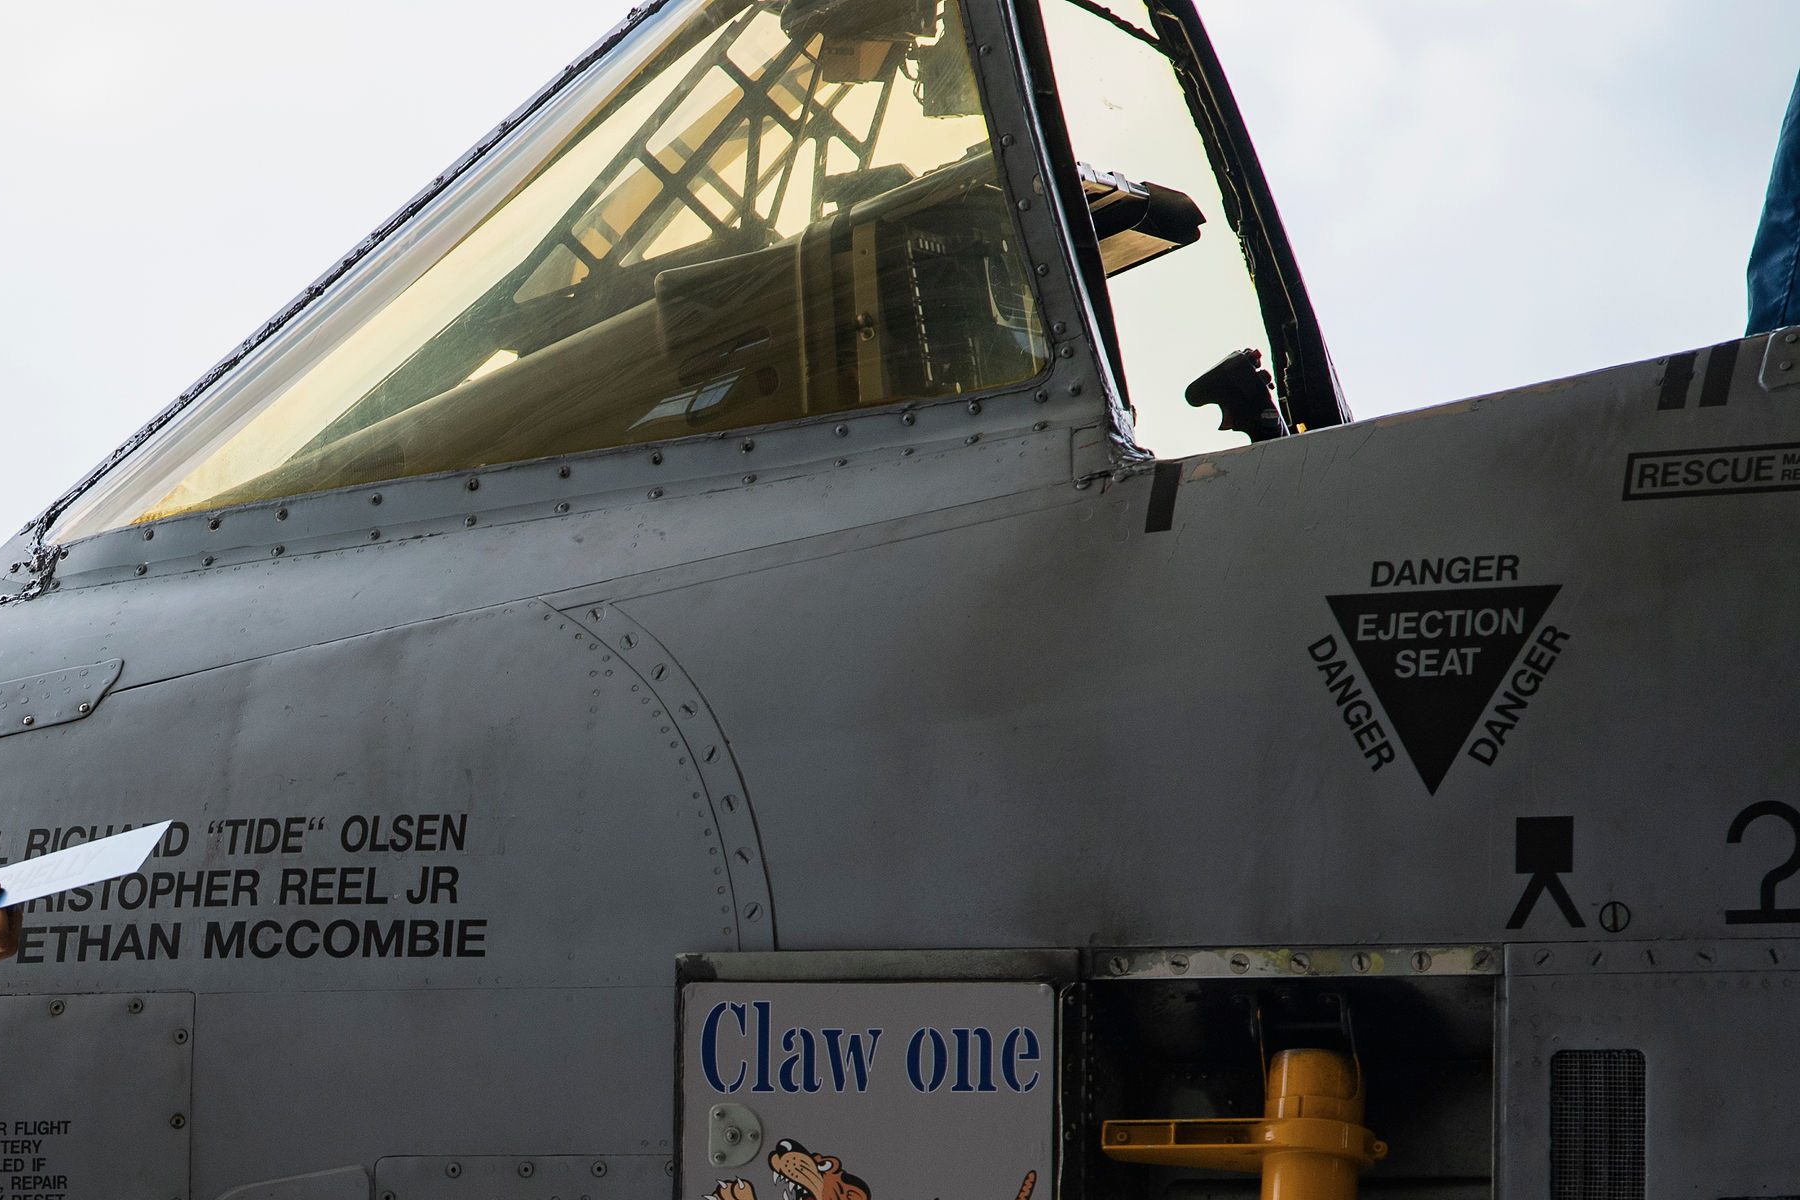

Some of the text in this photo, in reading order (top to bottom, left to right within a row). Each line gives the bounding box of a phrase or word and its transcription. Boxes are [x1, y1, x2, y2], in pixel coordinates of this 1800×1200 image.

[1637, 455, 1776, 488] RESCUE
[1370, 554, 1520, 587] DANGER
[1356, 607, 1525, 641] EJECTION
[1394, 648, 1481, 679] SEAT
[1307, 634, 1395, 772] DANGER
[1468, 625, 1571, 767] DANGER
[340, 814, 467, 853] OLSEN
[278, 866, 389, 905] REEL
[406, 866, 459, 904] JR
[16, 919, 488, 964] ETHAN MCCOMBIE
[700, 1000, 1042, 1094] Claw one
[15, 1120, 71, 1136] FLIGHT
[32, 1157, 47, 1172] IF
[11, 1175, 68, 1190] REPAIR
